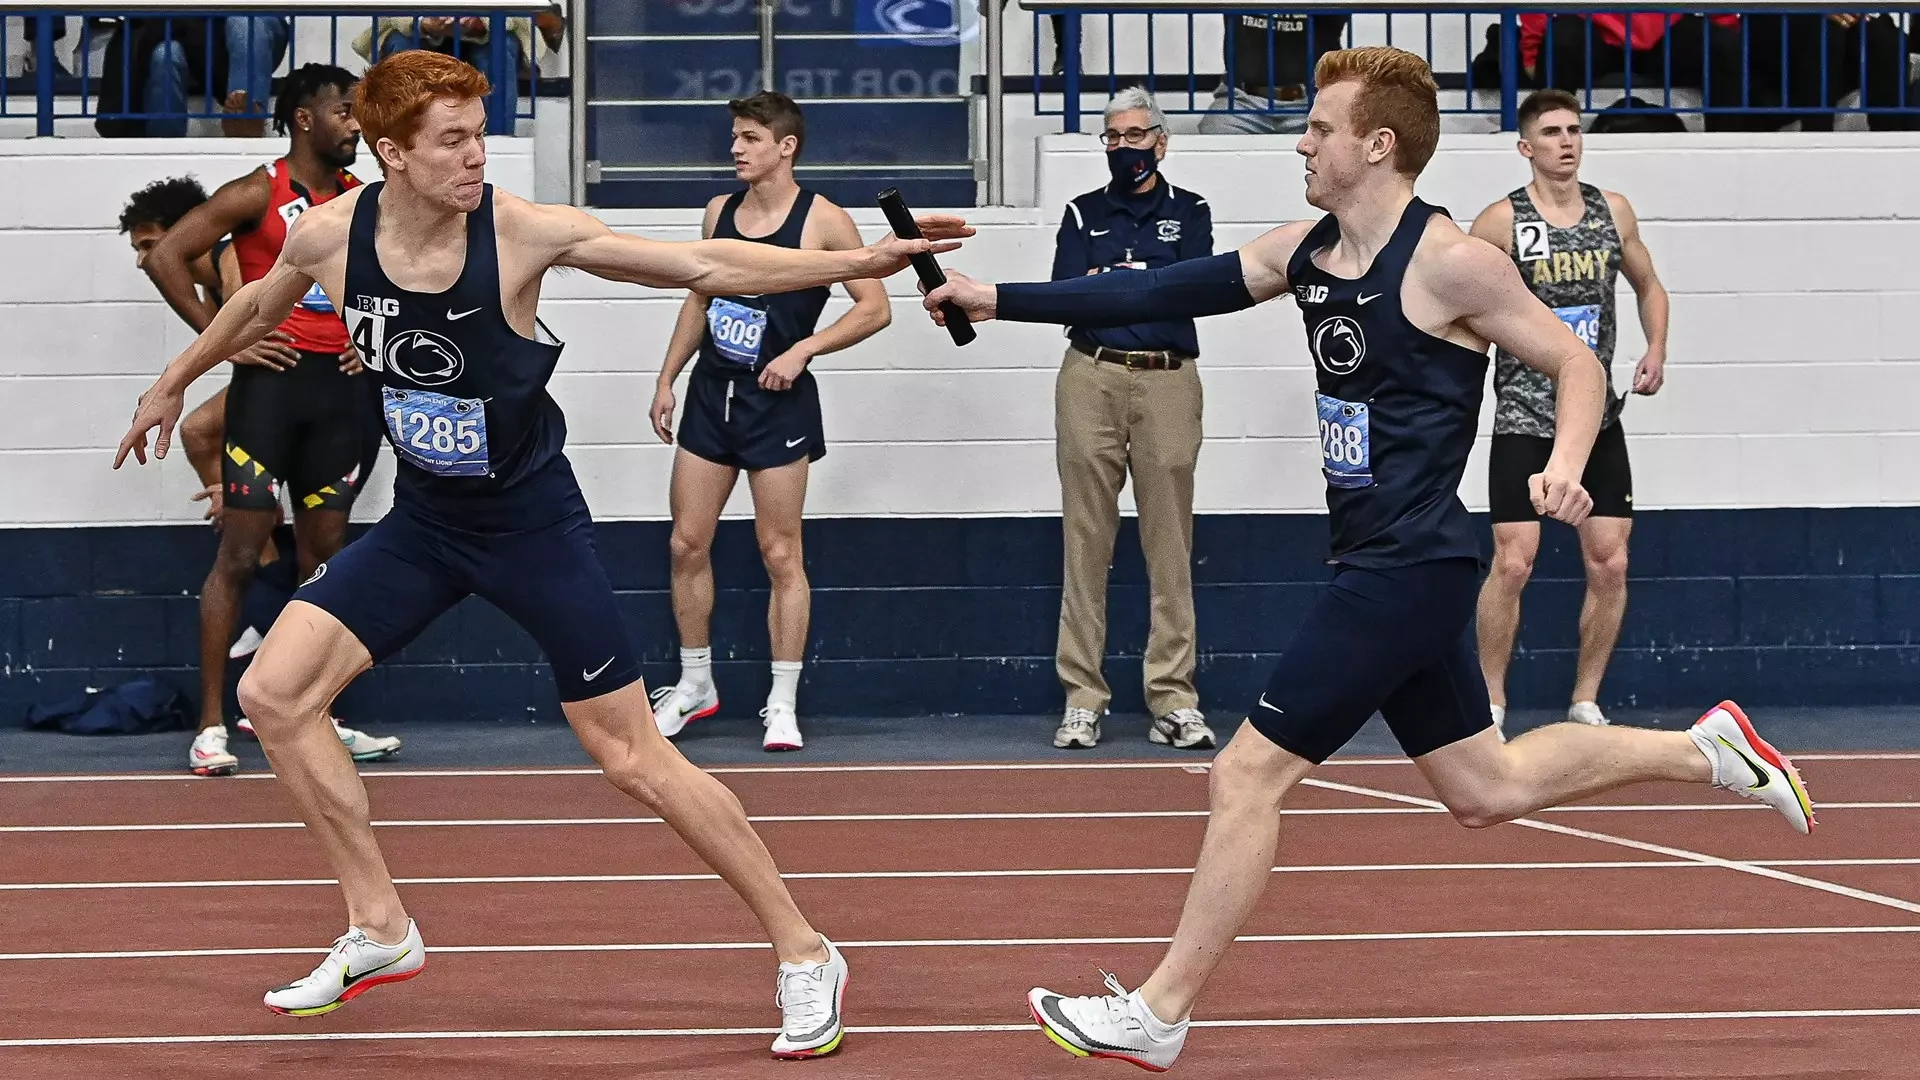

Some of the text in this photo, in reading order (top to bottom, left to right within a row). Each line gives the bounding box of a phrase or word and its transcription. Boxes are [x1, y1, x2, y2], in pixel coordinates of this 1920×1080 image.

[1521, 226, 1543, 258] 2
[1532, 249, 1610, 284] ARMY
[352, 316, 377, 366] 4
[1562, 319, 1599, 346] 49
[389, 408, 480, 455] 1285
